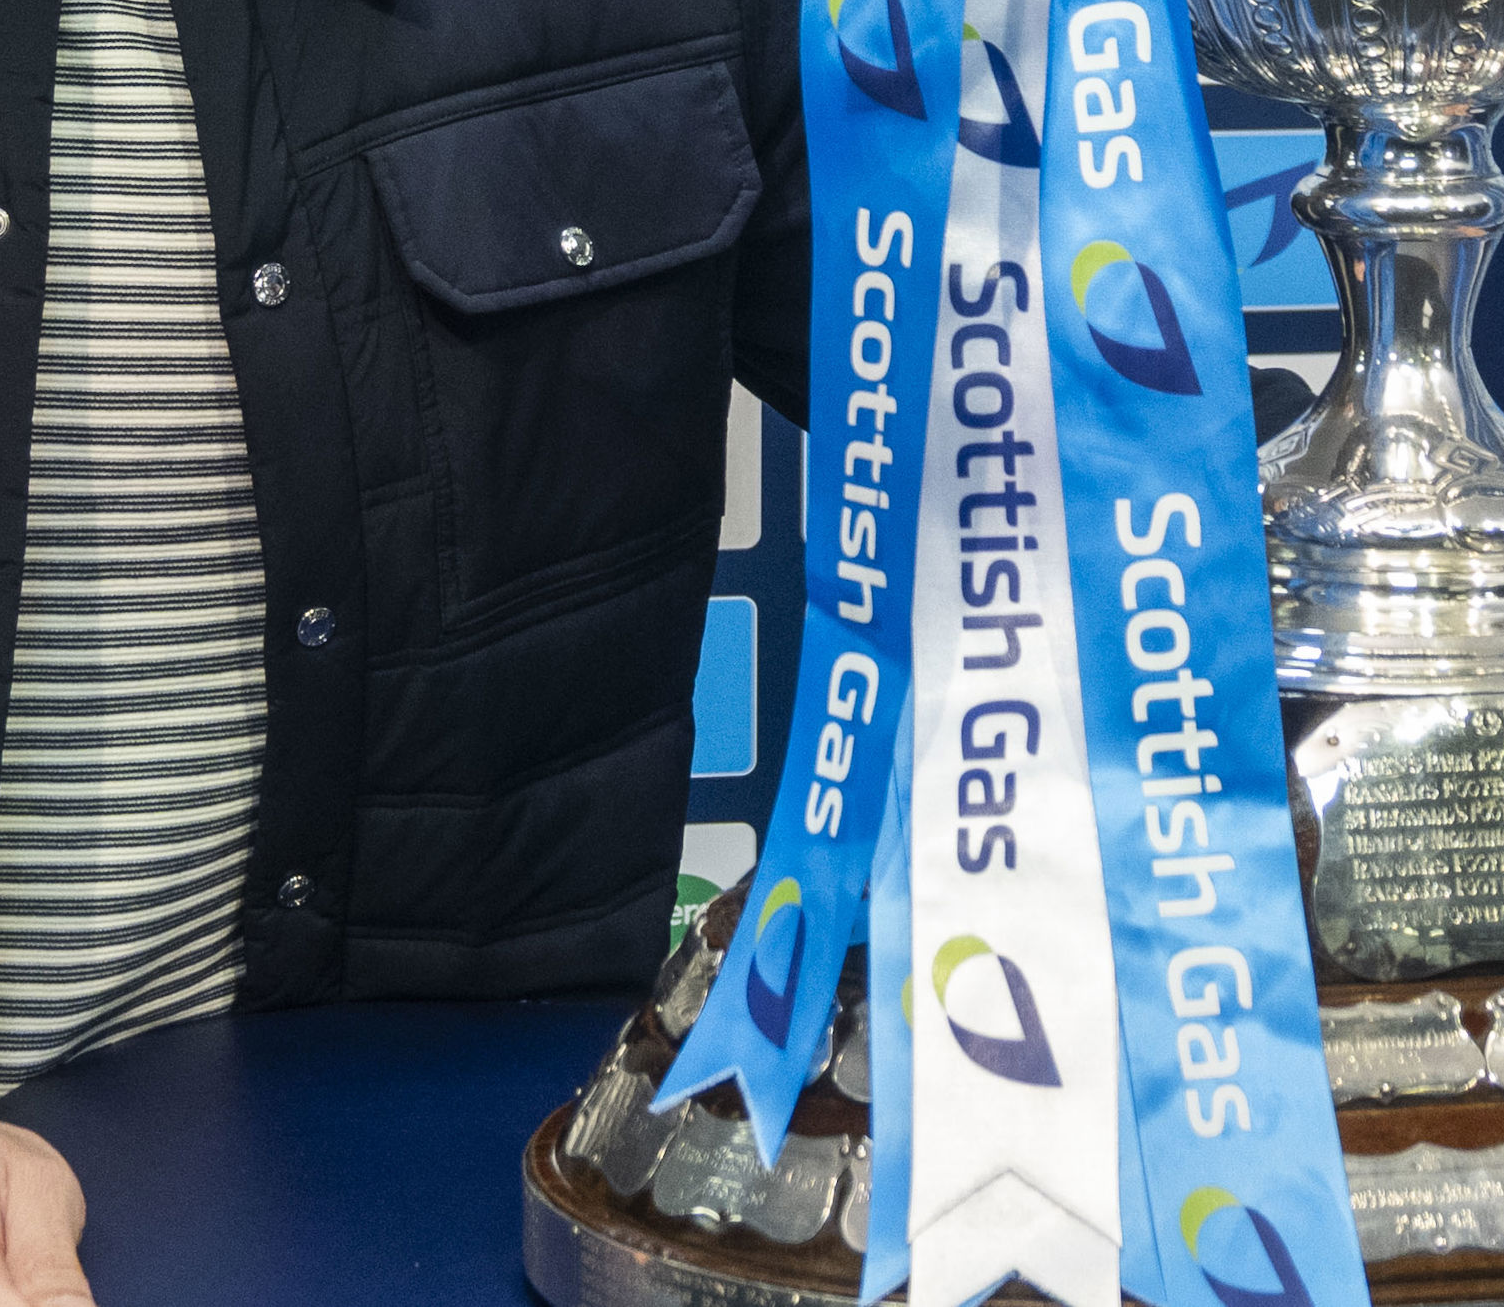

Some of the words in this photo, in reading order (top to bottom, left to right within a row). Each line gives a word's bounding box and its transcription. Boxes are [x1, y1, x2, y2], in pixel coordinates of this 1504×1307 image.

[1068, 0, 1152, 190] Gas
[837, 207, 915, 624] Scottish
[949, 260, 1043, 670] Scottish
[804, 652, 880, 838] Gas
[956, 699, 1041, 874] Gas
[1115, 492, 1236, 918] Scottish
[1166, 945, 1253, 1139] Gas
